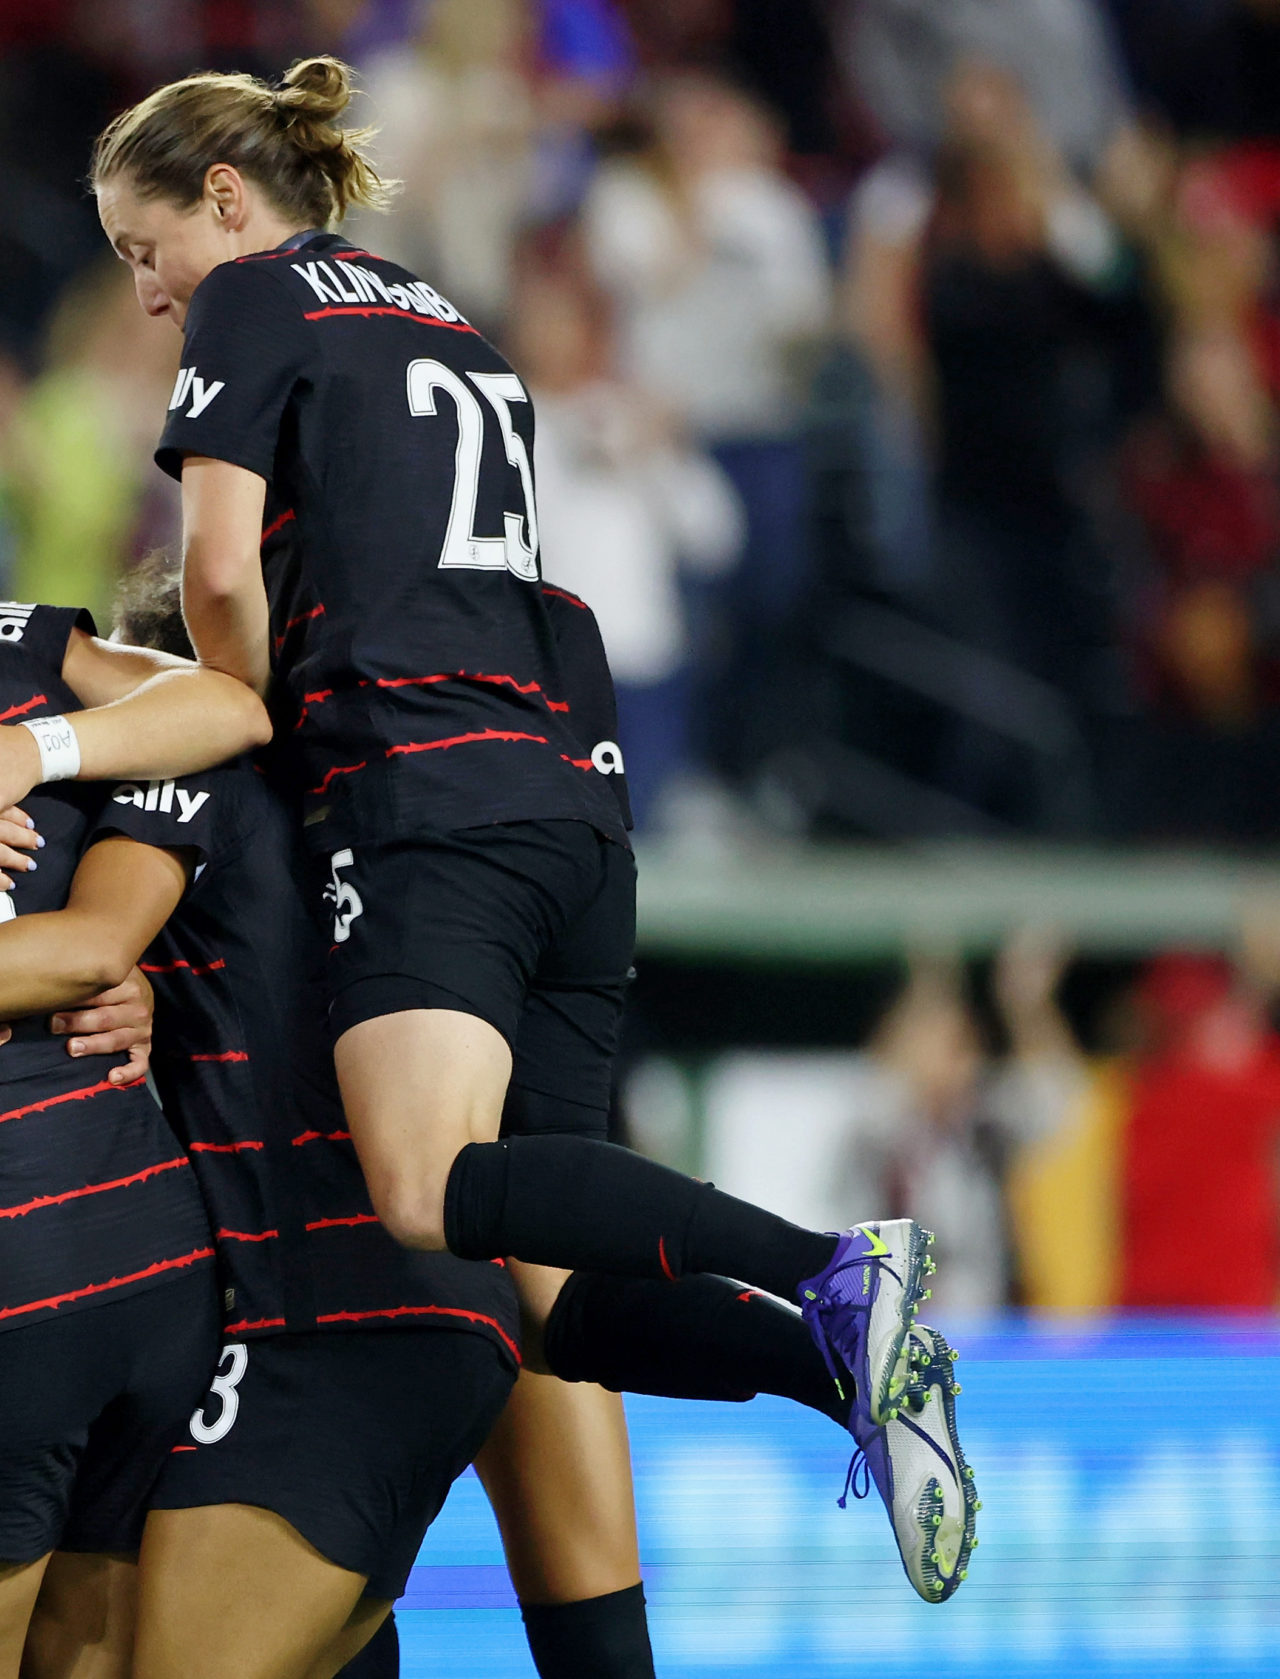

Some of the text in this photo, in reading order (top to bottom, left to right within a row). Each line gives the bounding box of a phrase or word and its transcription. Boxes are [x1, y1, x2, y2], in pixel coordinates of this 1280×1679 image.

[168, 366, 226, 418] lly
[406, 358, 539, 582] 25
[112, 780, 211, 823] ally
[322, 848, 364, 942] 5
[189, 1343, 249, 1444] 3
